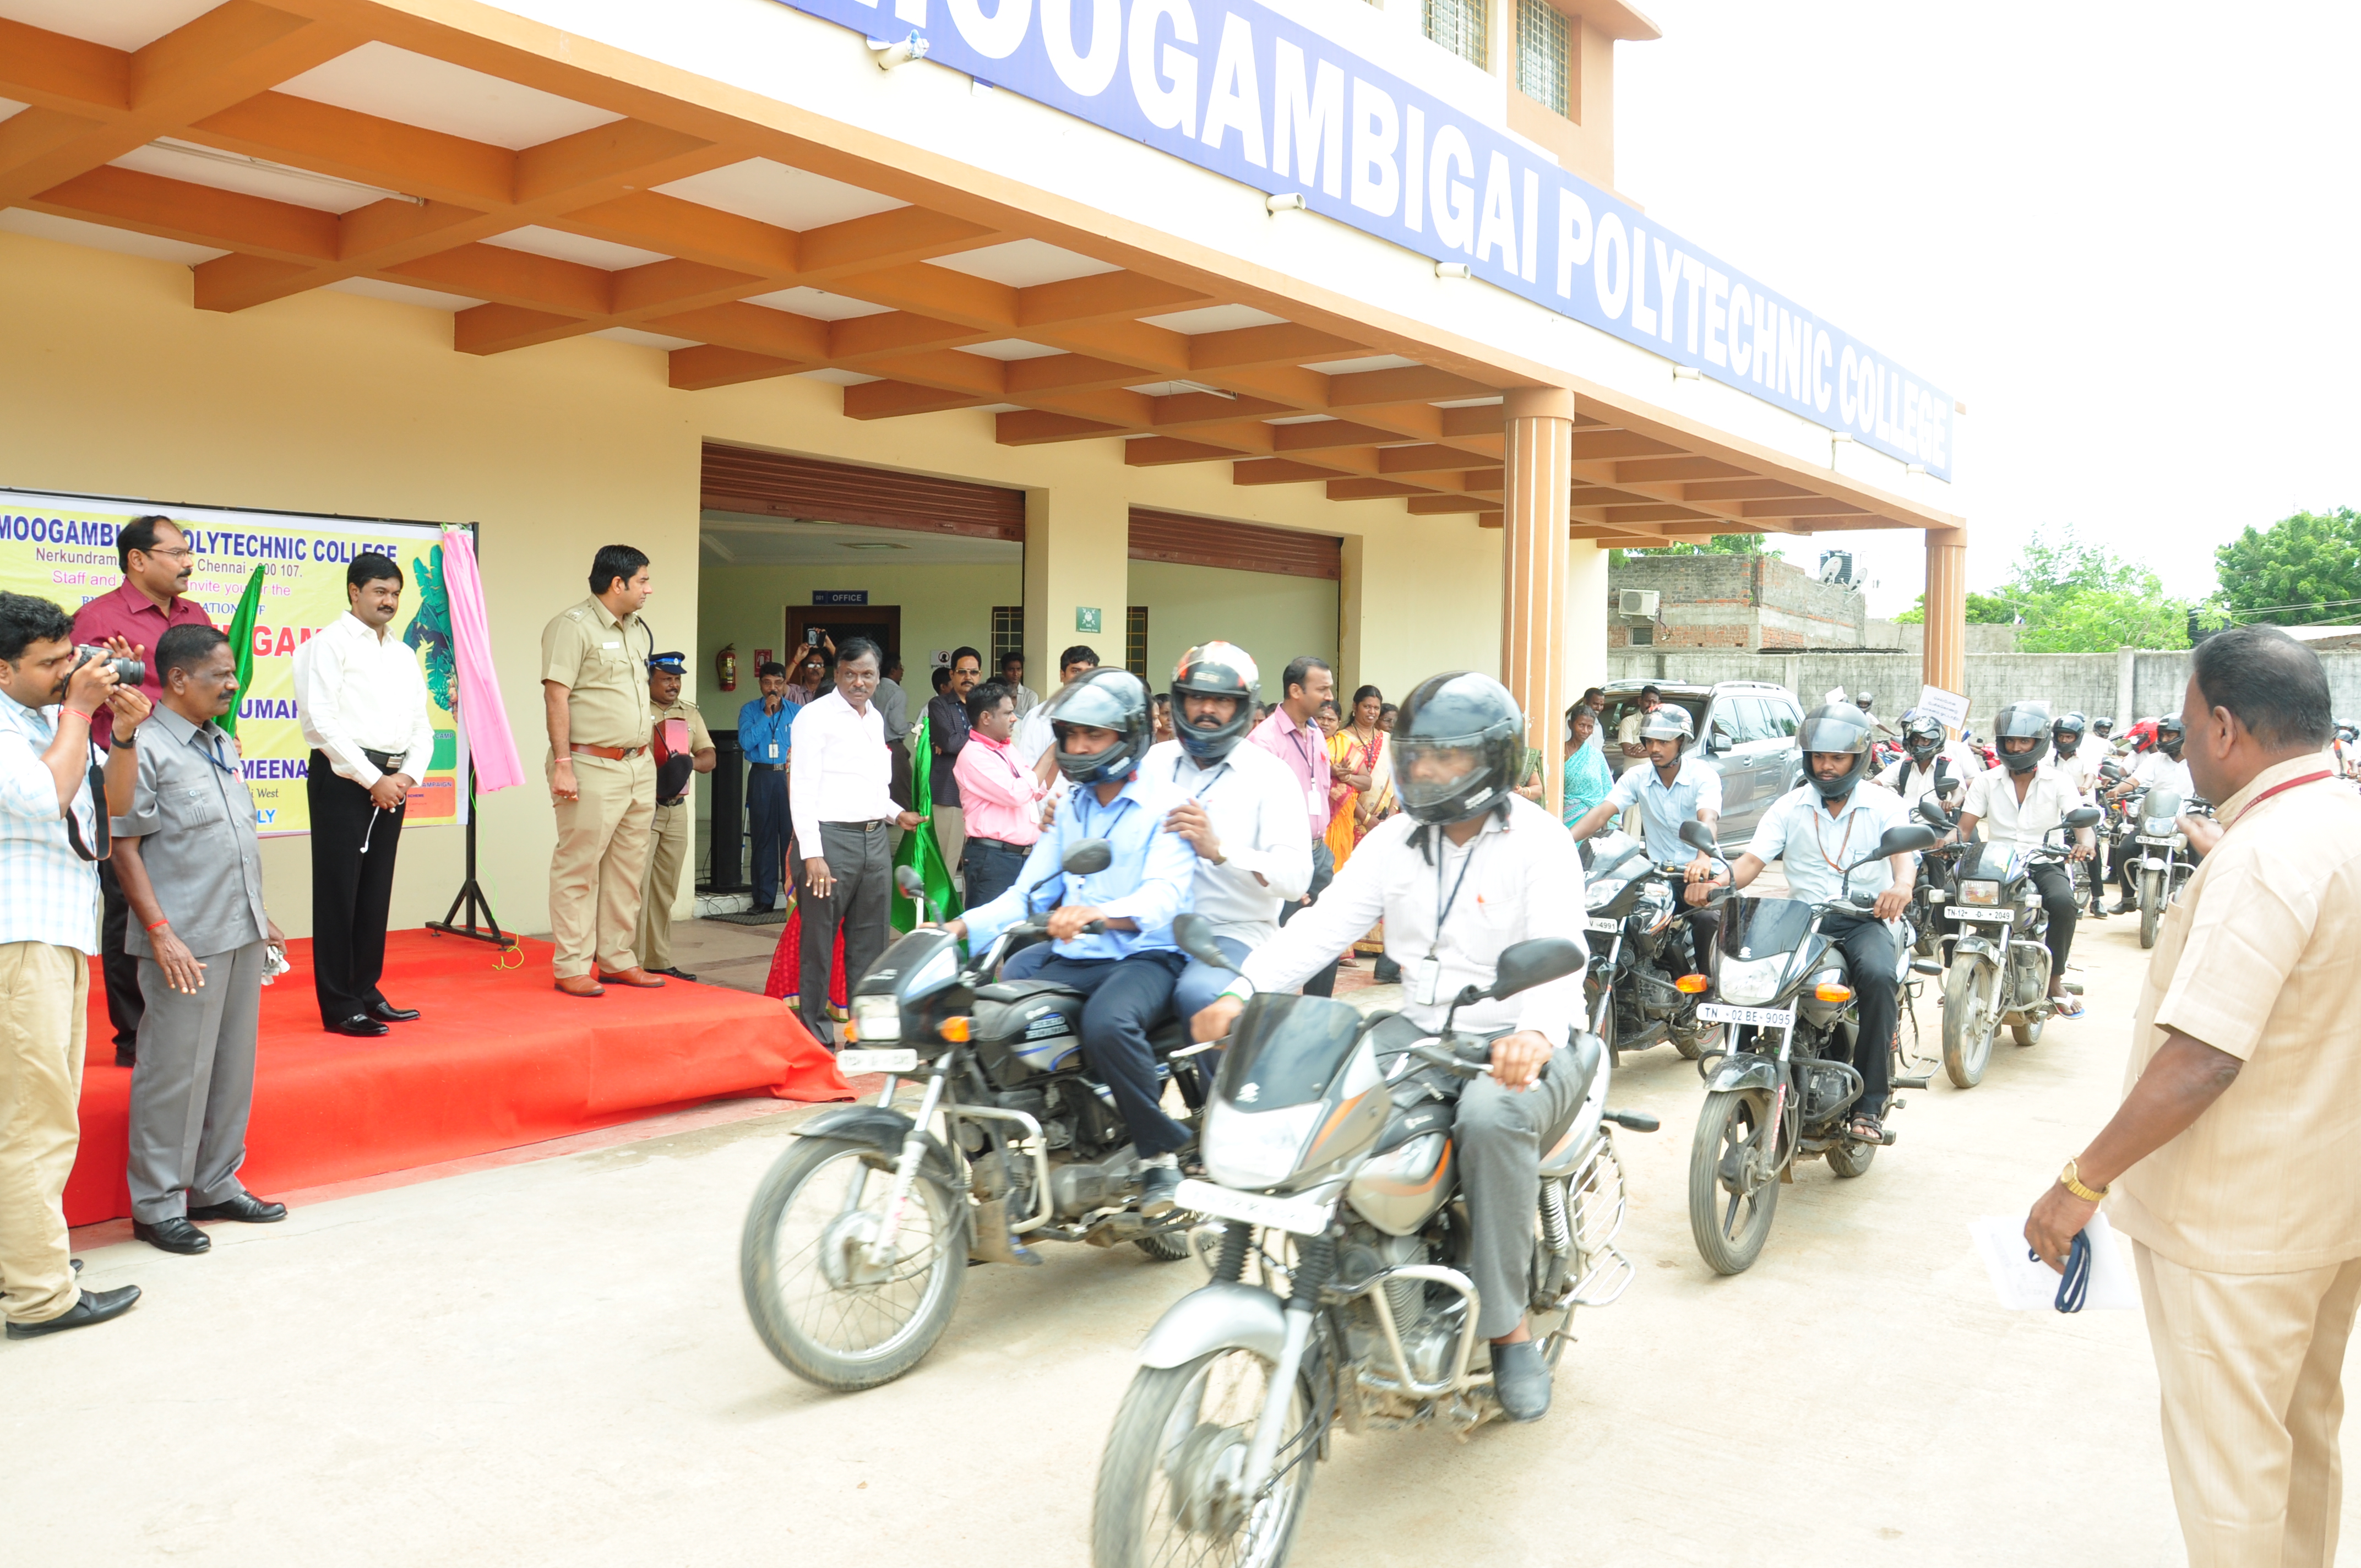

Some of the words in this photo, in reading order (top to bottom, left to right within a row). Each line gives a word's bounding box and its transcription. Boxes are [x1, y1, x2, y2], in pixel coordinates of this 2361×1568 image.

[1557, 187, 1832, 413] POLYTECHNIC
[1839, 345, 1947, 470] COLLEGE
[182, 529, 306, 560] OLYTECHNIC
[198, 558, 246, 574] Chennai
[281, 564, 302, 577] 107.
[53, 571, 86, 584] Staff
[91, 574, 116, 586] and
[272, 584, 290, 596] the
[257, 788, 279, 798] West
[1705, 1008, 1718, 1018] TN
[1732, 1010, 1743, 1021] 02
[1746, 1011, 1758, 1022] BE
[1766, 1012, 1790, 1025] 9095
